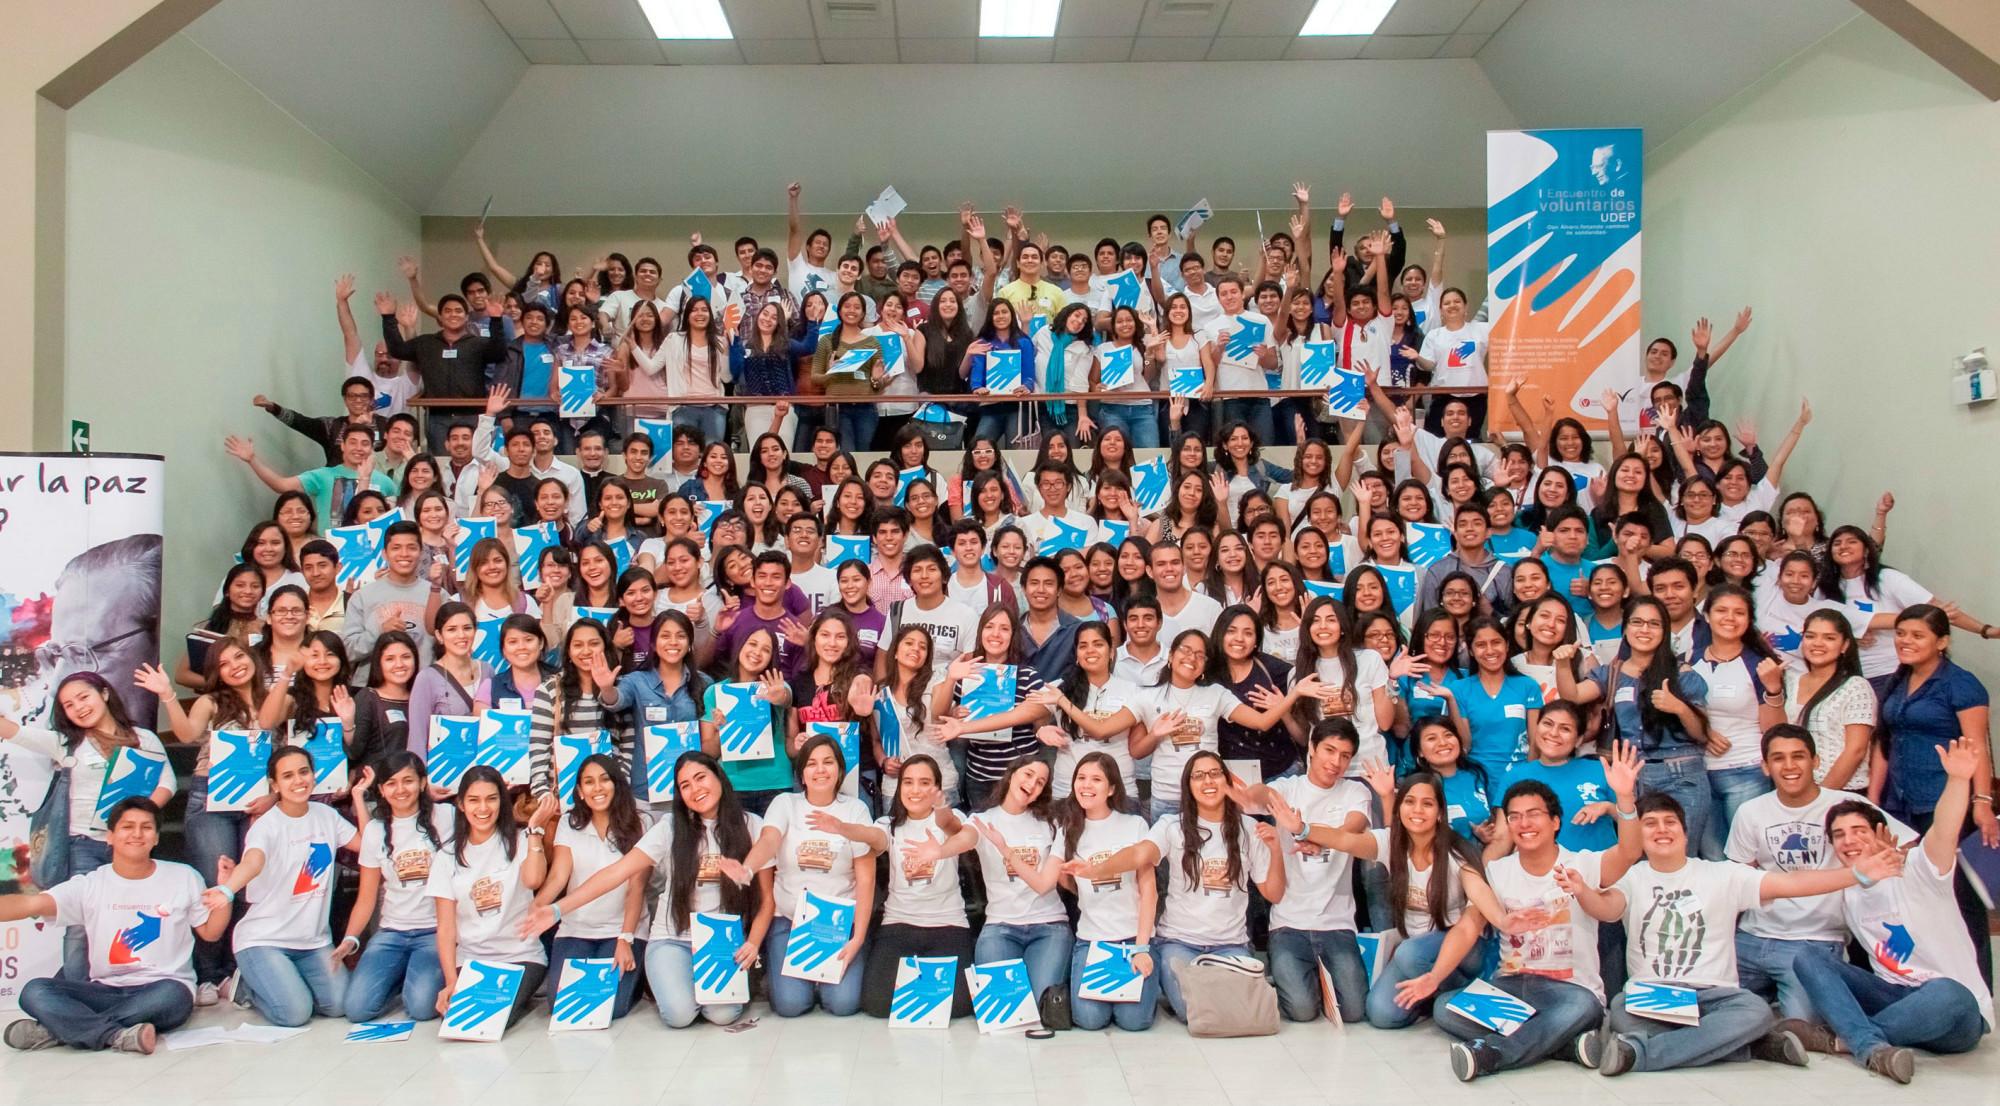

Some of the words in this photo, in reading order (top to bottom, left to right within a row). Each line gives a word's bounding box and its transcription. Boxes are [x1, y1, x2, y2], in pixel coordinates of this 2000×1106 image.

[1547, 189, 1607, 199] Encuentro
[1610, 188, 1625, 198] de
[1539, 198, 1635, 213] voluntarios
[1600, 212, 1636, 223] UDEP
[38, 461, 70, 494] la
[84, 474, 148, 505] paz
[1811, 835, 1822, 845] 87
[1777, 850, 1818, 865] CA-NY
[112, 903, 152, 911] Encuentro
[1554, 939, 1569, 948] NYC
